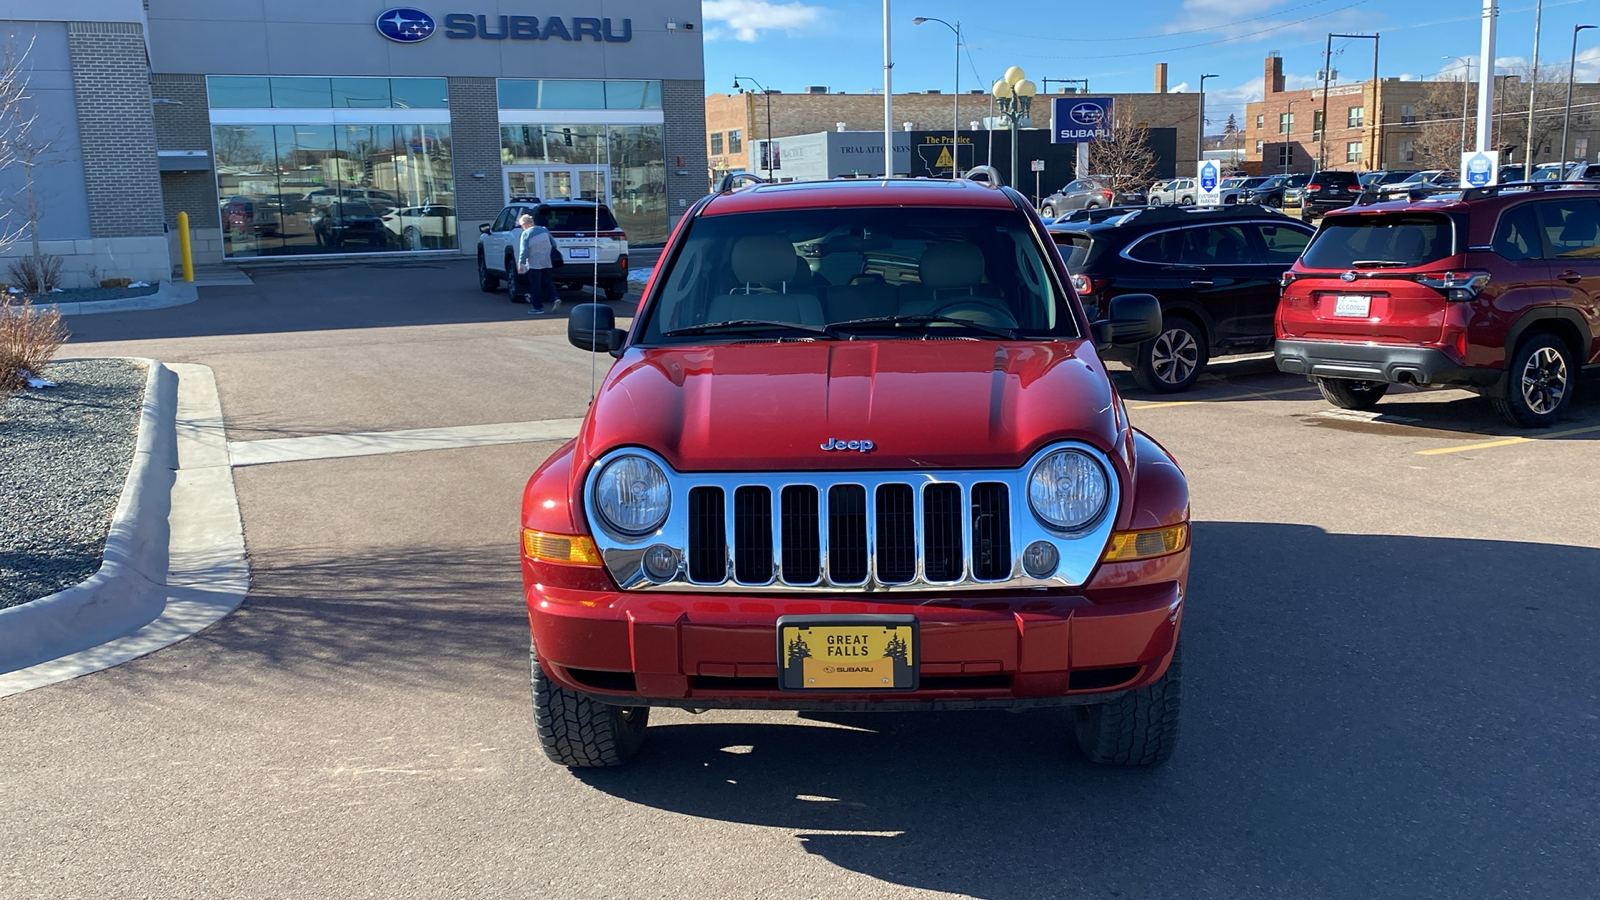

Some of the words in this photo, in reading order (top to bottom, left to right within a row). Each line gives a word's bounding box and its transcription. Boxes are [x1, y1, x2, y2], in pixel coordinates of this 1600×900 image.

[445, 13, 632, 42] SUBARU
[1061, 129, 1110, 138] SUBARU
[925, 135, 940, 144] The
[941, 135, 970, 144] Pratice
[841, 146, 865, 154] TRIAL
[866, 145, 911, 153] ATTONEYS
[820, 437, 874, 452] Jeep
[827, 635, 869, 645] GREAT
[827, 646, 869, 656] FALLS
